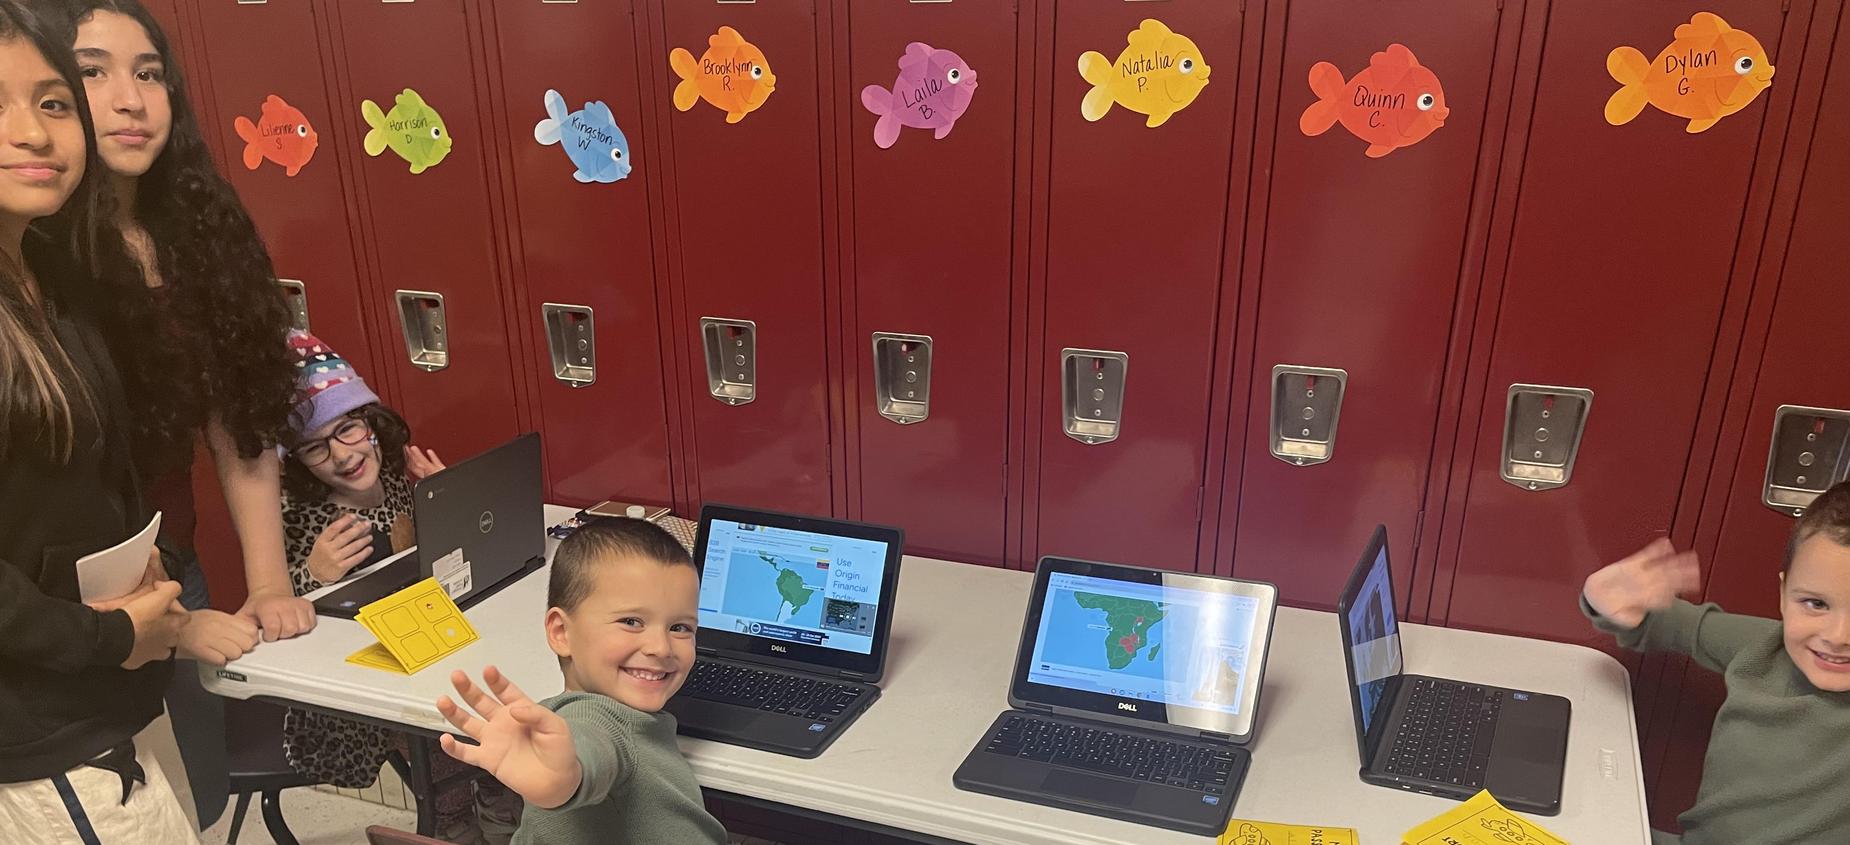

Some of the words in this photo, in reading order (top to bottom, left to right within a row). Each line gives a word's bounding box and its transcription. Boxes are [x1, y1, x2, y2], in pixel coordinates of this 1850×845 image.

[703, 57, 753, 76] Brooklynn
[1122, 50, 1175, 78] Natalia
[1665, 48, 1717, 75] Dylan
[722, 75, 735, 91] R.
[1137, 76, 1150, 93] P.
[1677, 77, 1695, 96] G.
[901, 78, 943, 109] Laila
[1353, 85, 1405, 109] Quinn
[918, 104, 936, 120] B.
[1369, 110, 1385, 128] C.
[389, 117, 428, 131] Harrison
[571, 116, 613, 145] Kingston
[404, 134, 412, 144] D
[578, 136, 591, 150] W
[836, 557, 852, 567] Use
[835, 569, 860, 581] Origin
[833, 580, 869, 593] Financial
[771, 644, 787, 653] DELL
[1118, 702, 1137, 712] DELL
